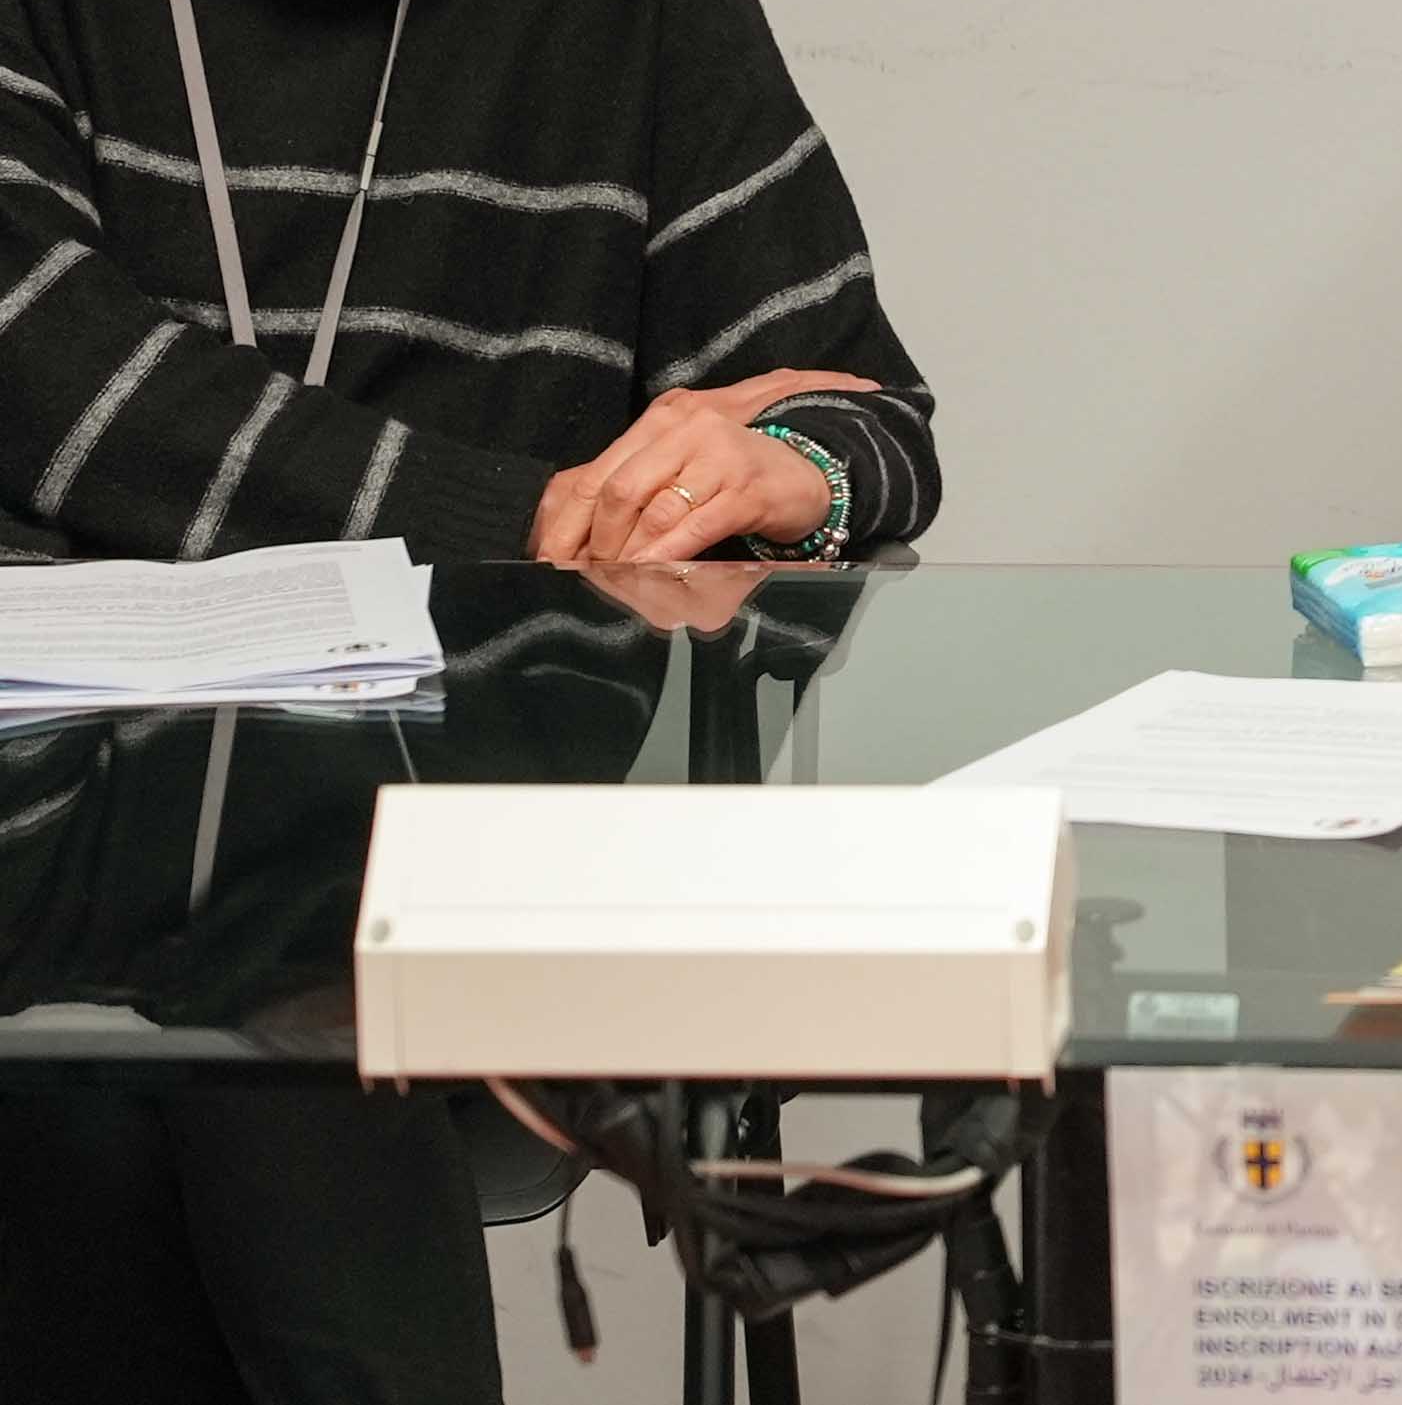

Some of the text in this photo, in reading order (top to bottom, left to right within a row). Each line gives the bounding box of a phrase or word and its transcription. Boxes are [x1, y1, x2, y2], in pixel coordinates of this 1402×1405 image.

[1198, 1276, 1336, 1296] ISCRIZIONE
[1197, 1308, 1351, 1327] ENROLMENT
[1365, 1309, 1386, 1328] IN
[1197, 1338, 1357, 1357] INSCRIPTION
